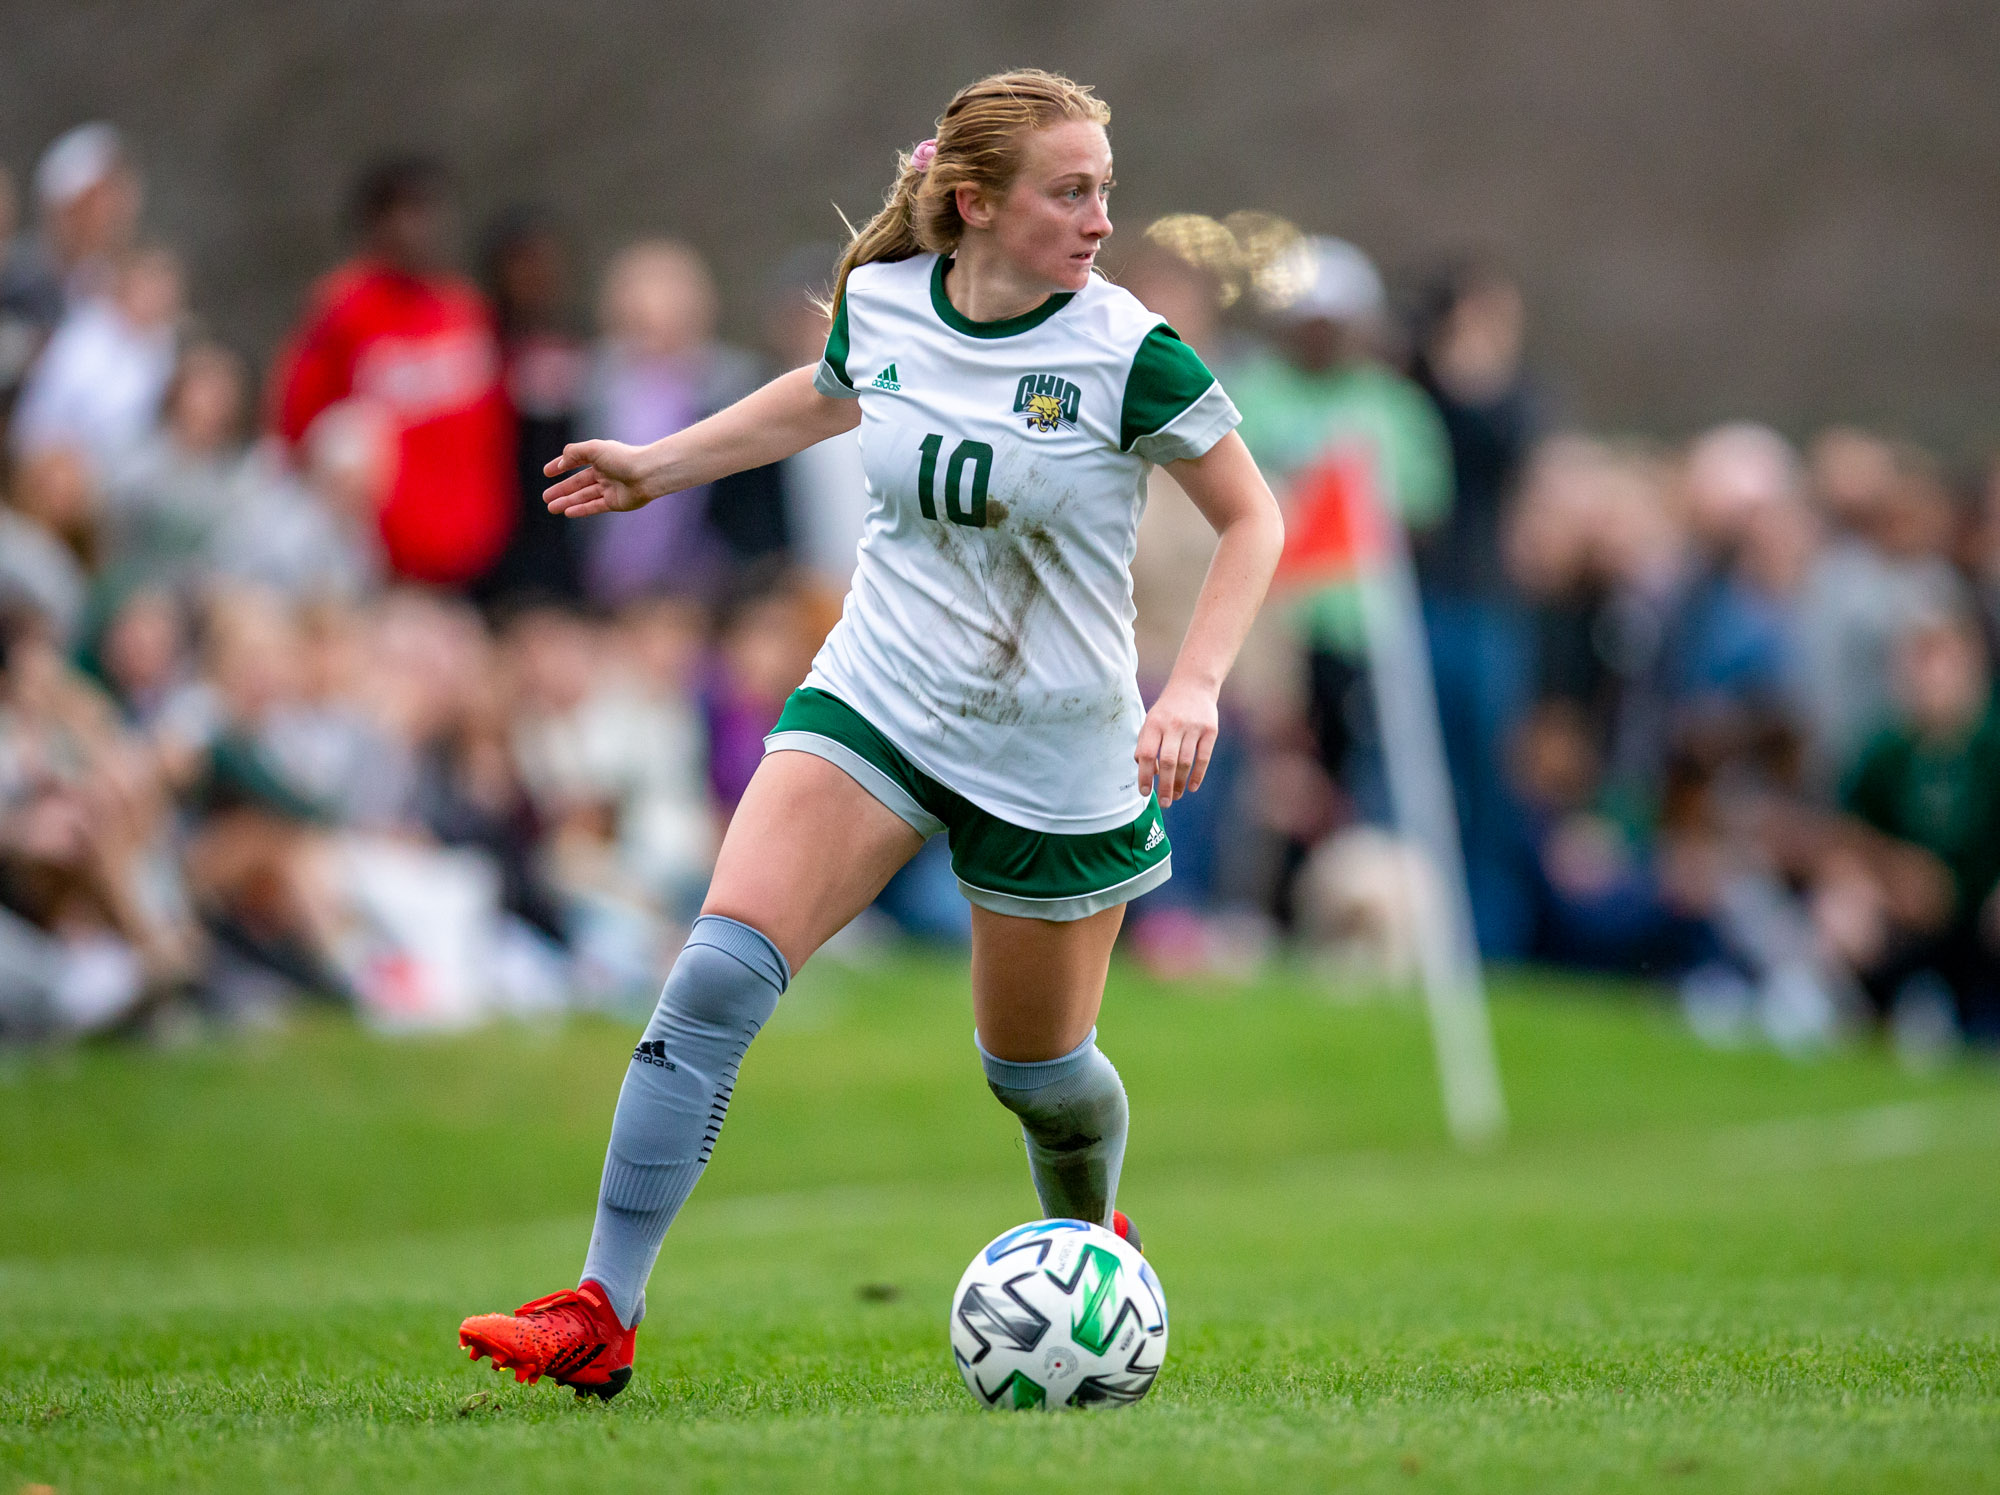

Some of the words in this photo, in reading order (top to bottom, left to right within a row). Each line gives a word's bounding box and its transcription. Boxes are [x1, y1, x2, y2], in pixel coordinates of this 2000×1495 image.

[872, 378, 901, 391] adidas
[1014, 374, 1081, 423] OHIO
[918, 433, 994, 528] 10
[1144, 830, 1165, 851] adidas
[632, 1052, 677, 1072] didas
